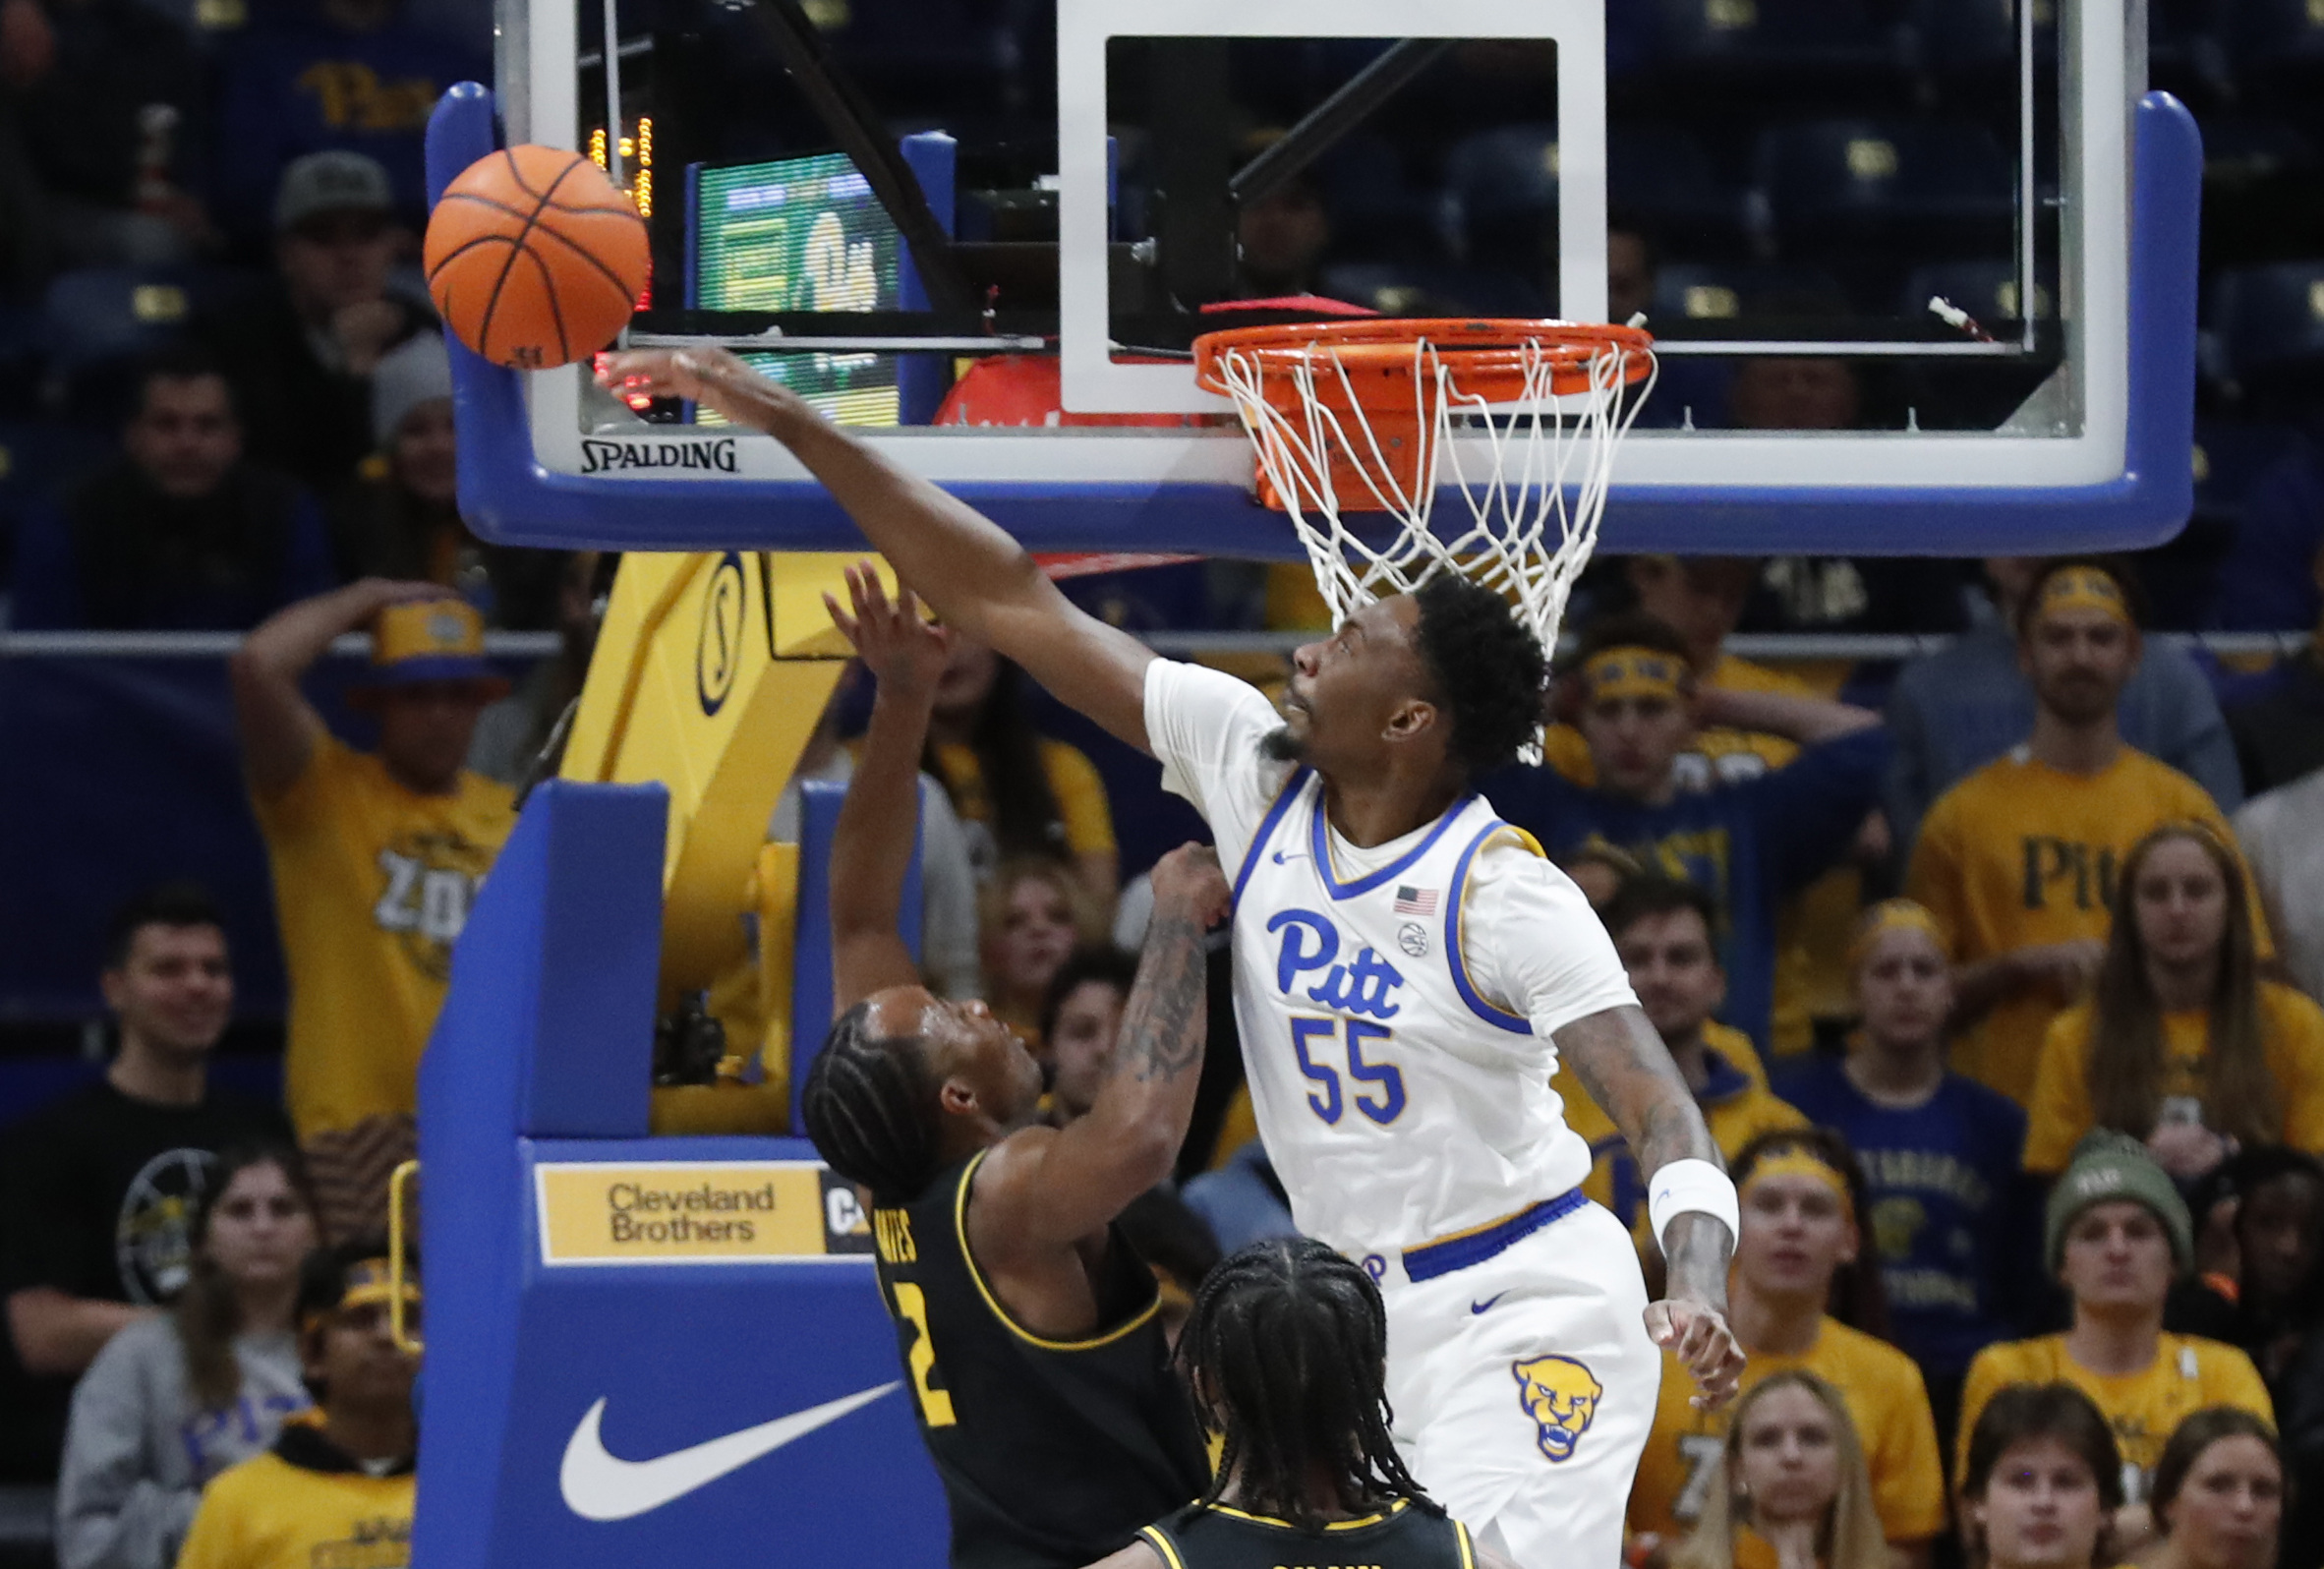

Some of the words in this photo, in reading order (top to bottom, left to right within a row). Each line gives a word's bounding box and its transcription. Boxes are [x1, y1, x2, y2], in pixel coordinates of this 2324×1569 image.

[581, 438, 737, 474] SPALDING
[375, 848, 488, 940] ZO
[1267, 907, 1405, 1019] Pitt
[1289, 1015, 1408, 1127] 55
[609, 1183, 775, 1212] Cleveland
[610, 1212, 755, 1243] Brothers
[893, 1281, 958, 1426] 2
